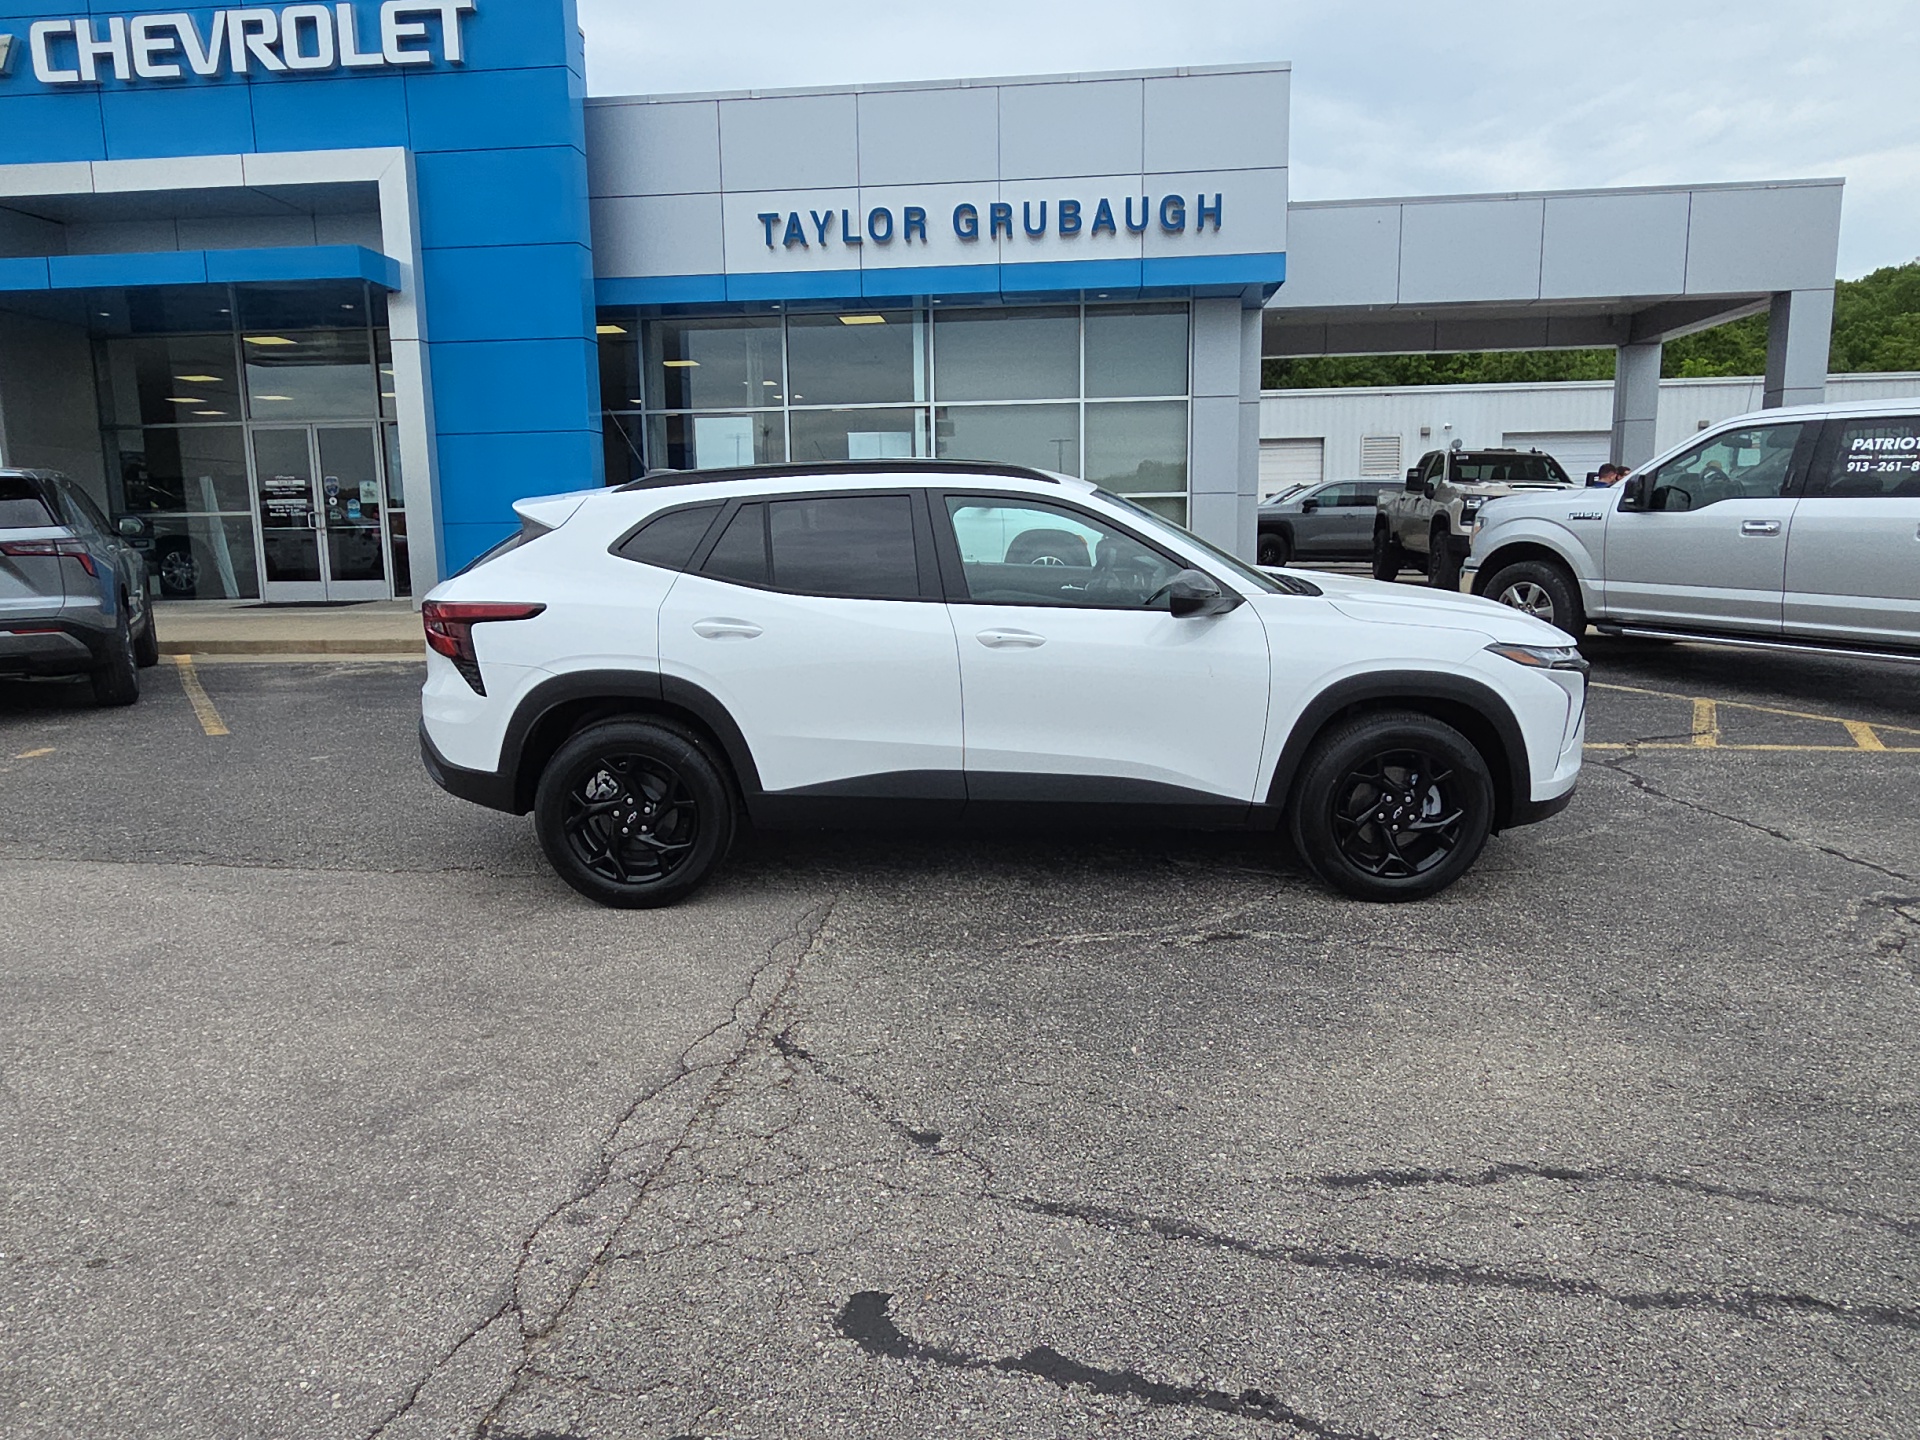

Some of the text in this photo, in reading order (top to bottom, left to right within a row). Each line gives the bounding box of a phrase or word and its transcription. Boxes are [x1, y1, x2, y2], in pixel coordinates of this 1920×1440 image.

[30, 0, 472, 83] CHEVROLET
[757, 193, 1222, 248] TAYLOR GRUBAUGH
[1846, 461, 1920, 472] 913-261-8
